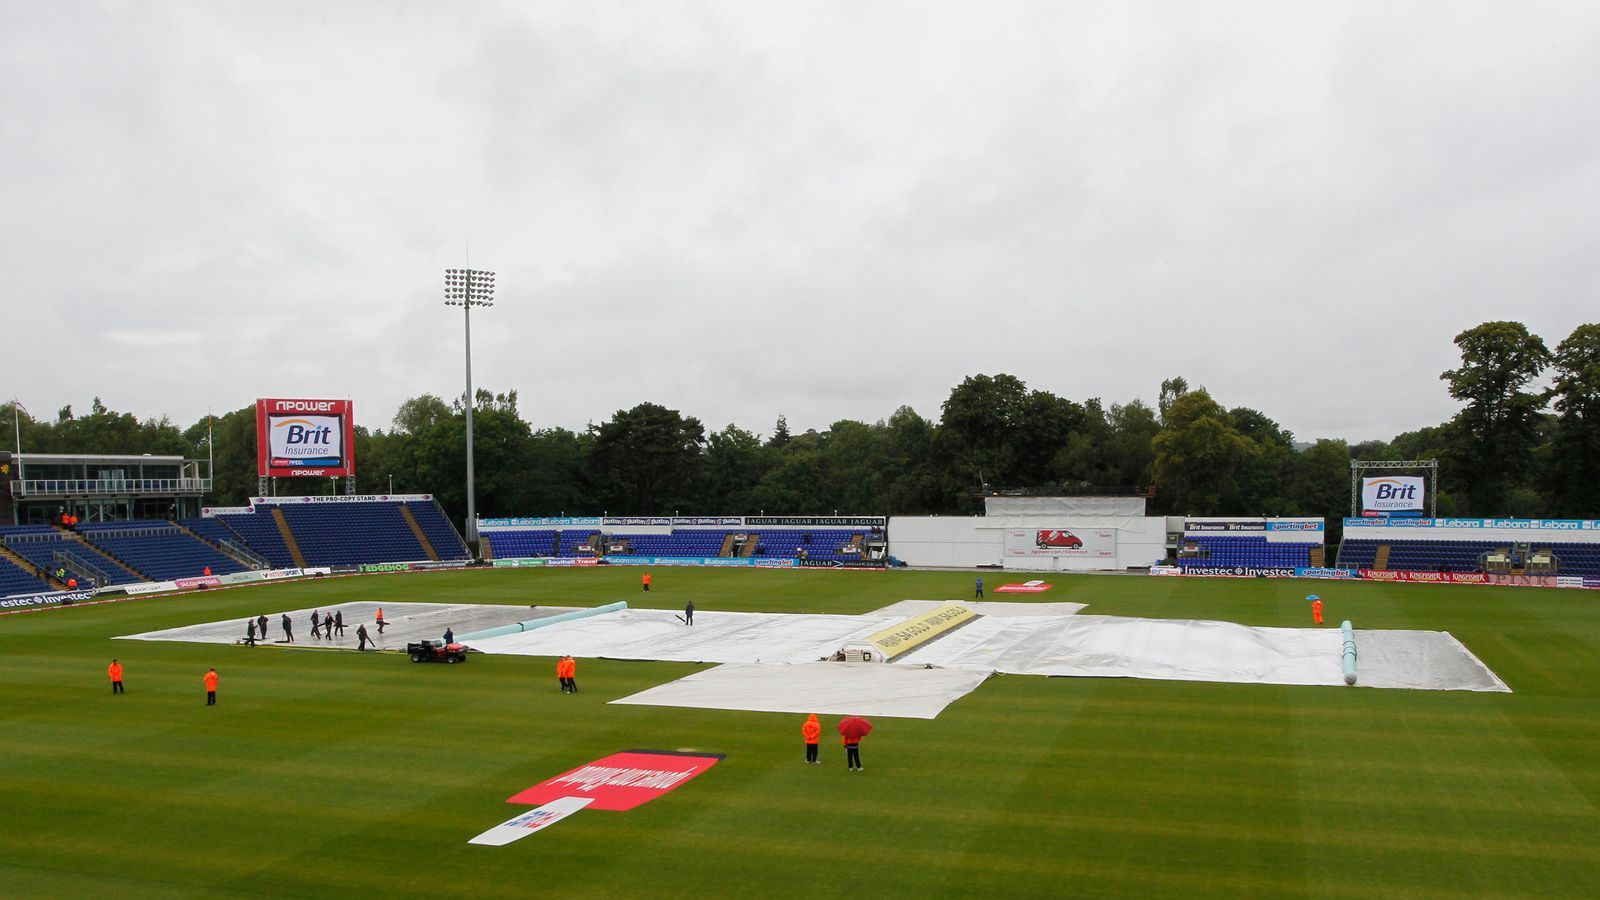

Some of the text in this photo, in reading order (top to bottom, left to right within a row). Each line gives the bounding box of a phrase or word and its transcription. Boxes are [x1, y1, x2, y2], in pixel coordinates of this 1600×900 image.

[276, 401, 336, 411] npower
[287, 425, 332, 444] Brit
[285, 446, 328, 455] Insurance
[1376, 484, 1416, 499] Brit
[1374, 500, 1413, 508] Insurance
[1273, 523, 1318, 531] sportingbet
[1493, 520, 1529, 528] Lebara
[1185, 566, 1233, 575] Investec
[1245, 567, 1294, 576] Investec
[1304, 569, 1349, 577] sportingbet
[1367, 571, 1398, 579] KINGFISHER
[1409, 572, 1442, 580] KINGFISHER
[1452, 573, 1485, 581] KINGFISHER
[1496, 576, 1550, 585] PINK
